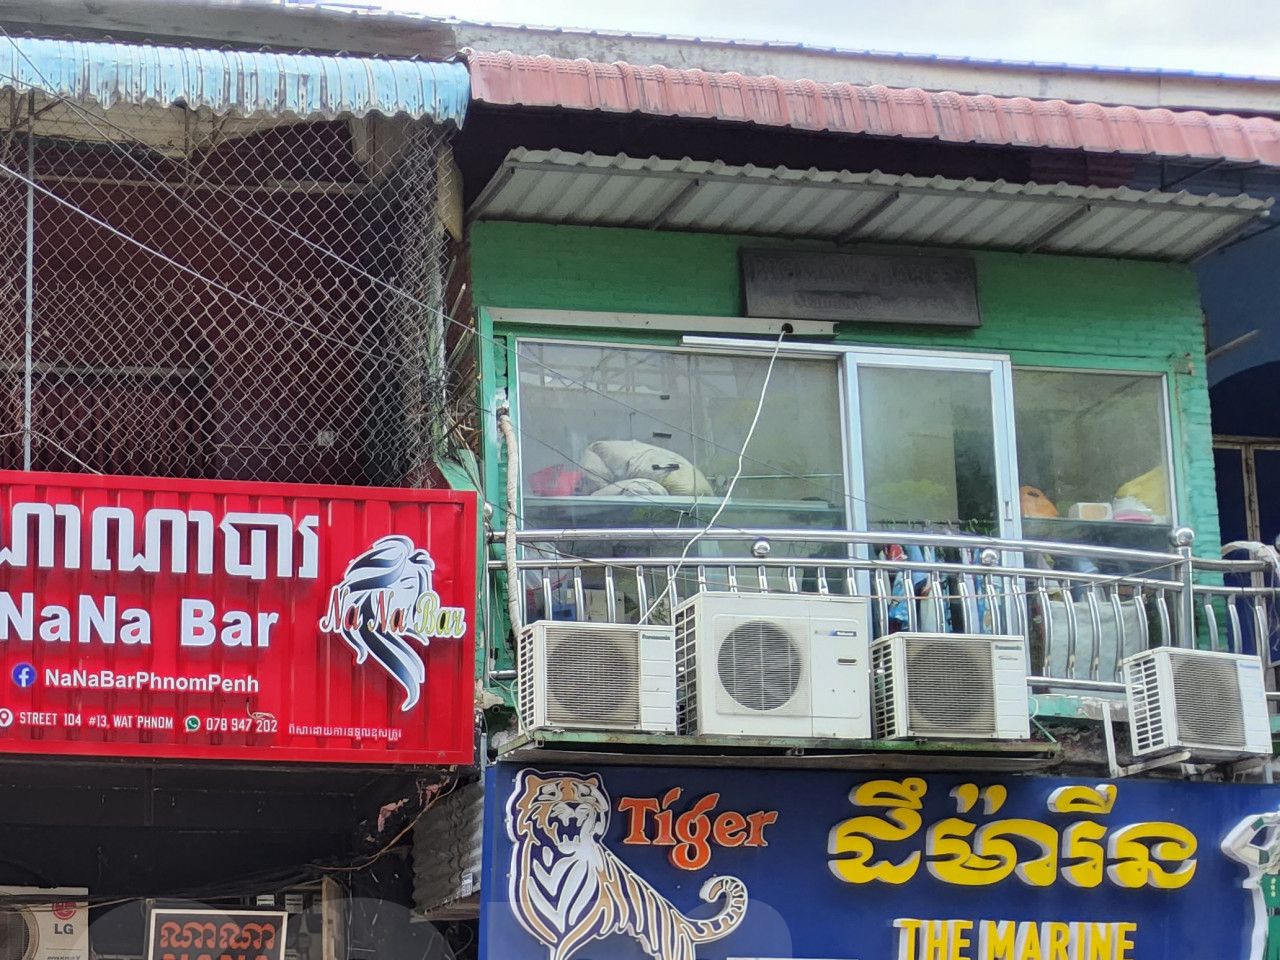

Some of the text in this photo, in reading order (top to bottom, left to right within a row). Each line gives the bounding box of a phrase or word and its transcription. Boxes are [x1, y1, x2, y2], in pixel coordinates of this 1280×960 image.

[181, 598, 279, 649] Bar
[44, 667, 260, 694] NaNaBarPhnomPenh
[19, 711, 58, 726] STREET
[63, 712, 82, 727] 104
[113, 714, 133, 729] WAT
[137, 715, 174, 730] PHNOM
[205, 717, 228, 732] 078
[231, 717, 252, 732] 947
[255, 719, 278, 734] 202
[617, 785, 779, 871] Tiger
[54, 923, 74, 935] LG
